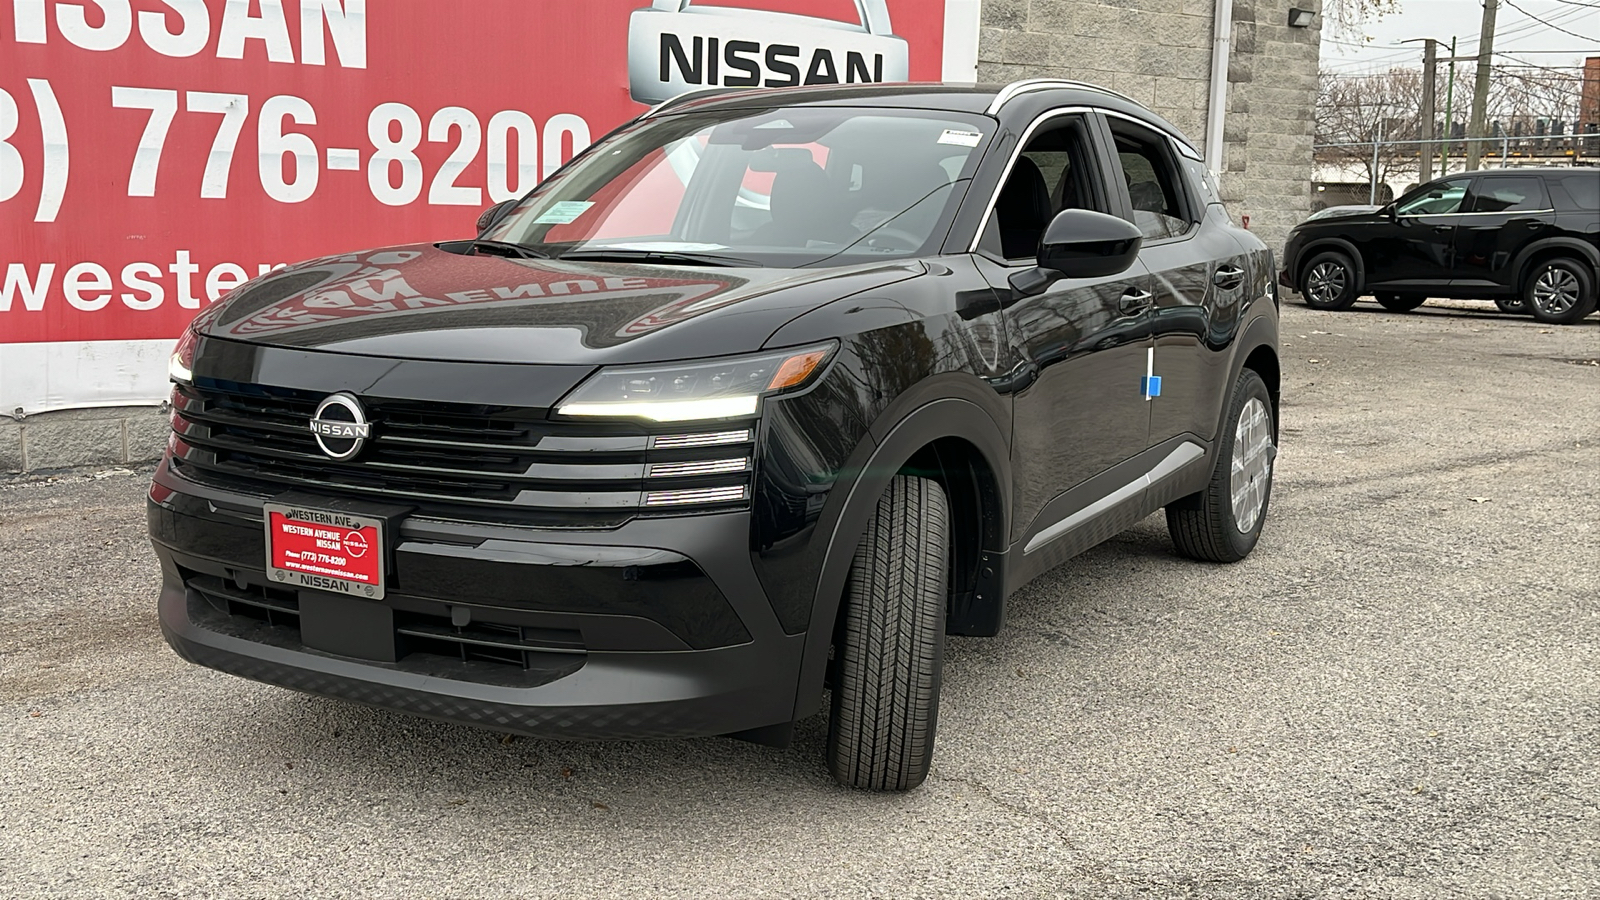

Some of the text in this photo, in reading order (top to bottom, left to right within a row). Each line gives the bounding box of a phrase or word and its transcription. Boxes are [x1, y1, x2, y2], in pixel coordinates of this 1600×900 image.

[660, 33, 882, 87] NISSAN
[111, 86, 591, 206] 776-8200
[310, 421, 367, 437] NISSAN
[291, 509, 332, 524] WESTERN
[282, 524, 341, 541] WESTERN AVENUE
[316, 539, 341, 551] NISSAN
[343, 540, 368, 549] NISSAN
[301, 551, 317, 563] (773)
[318, 554, 346, 566] 776-8200
[300, 574, 349, 592] NISSAN
